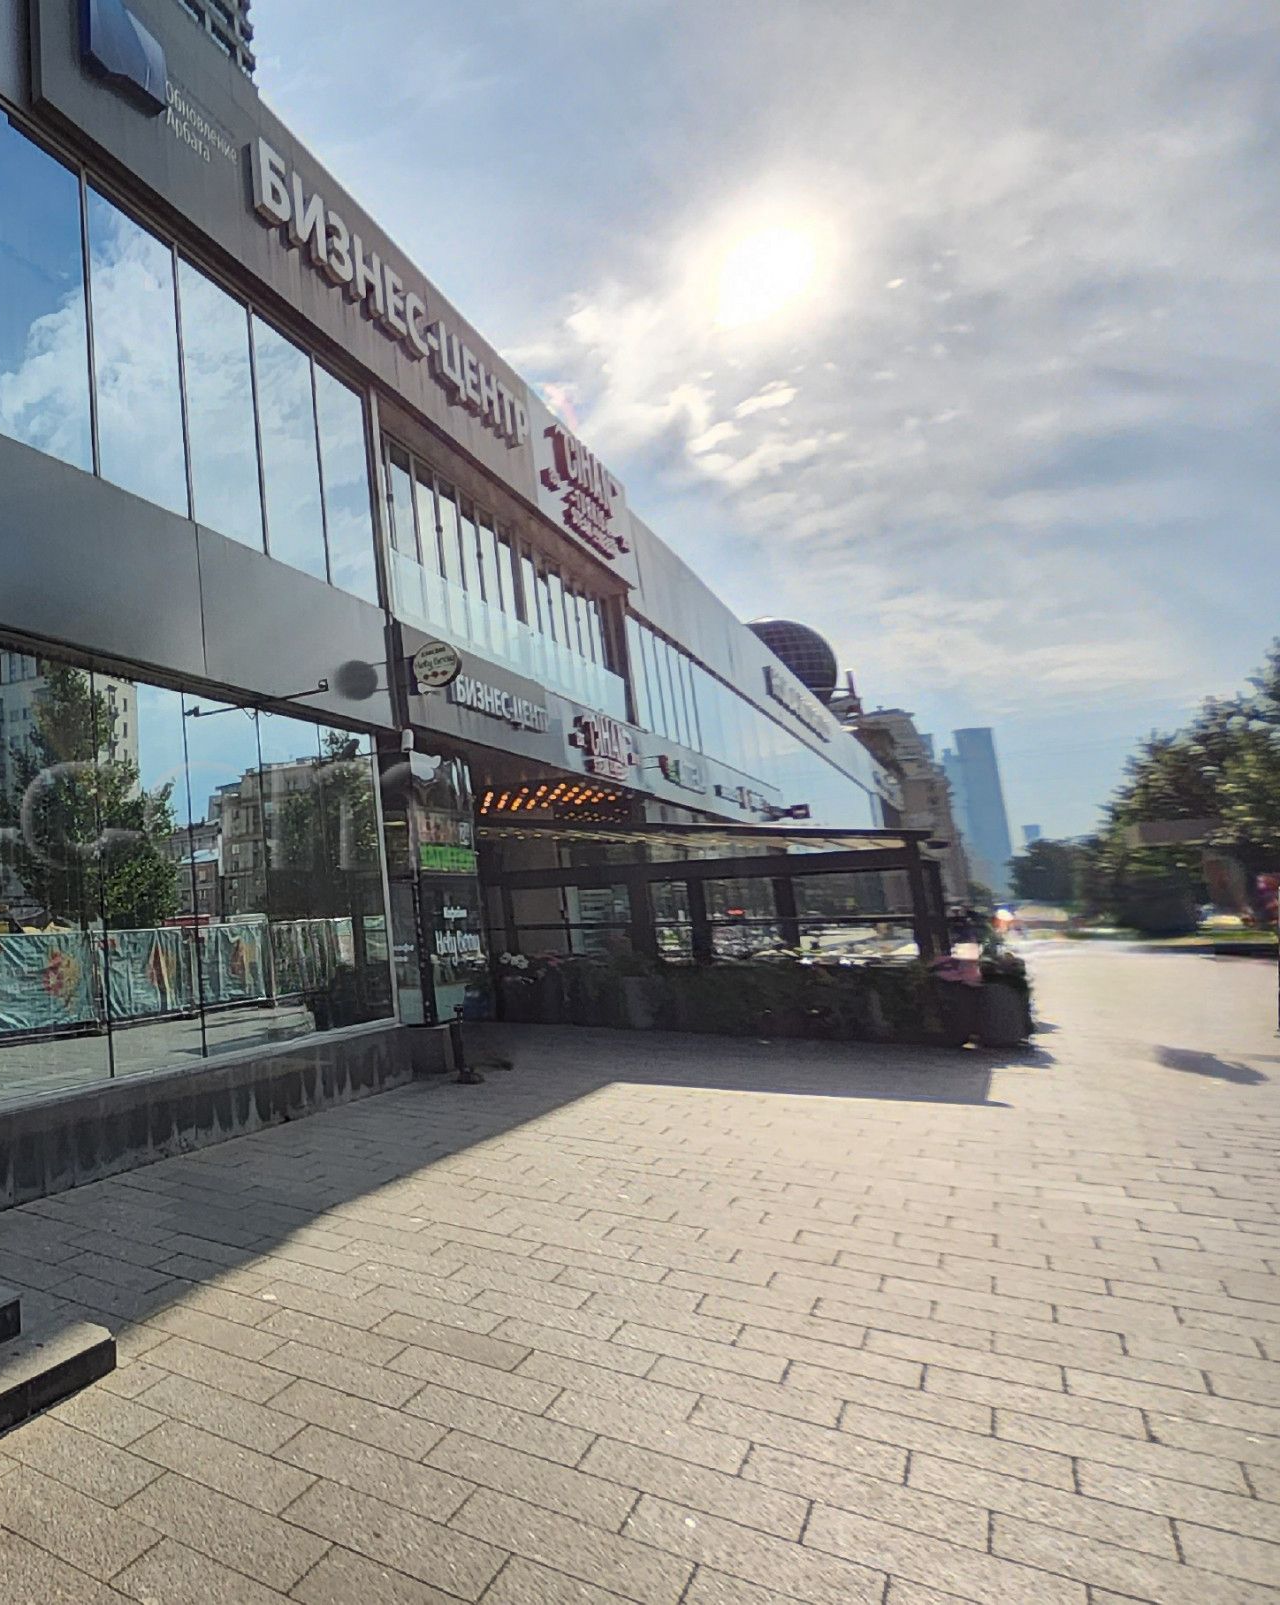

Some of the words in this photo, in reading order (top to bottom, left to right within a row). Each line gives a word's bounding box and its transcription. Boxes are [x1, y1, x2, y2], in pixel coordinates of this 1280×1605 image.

[165, 80, 238, 165] Обновление
[166, 106, 211, 163] Арбата
[254, 137, 531, 448] БИЗНЕС-ЦЕНТР
